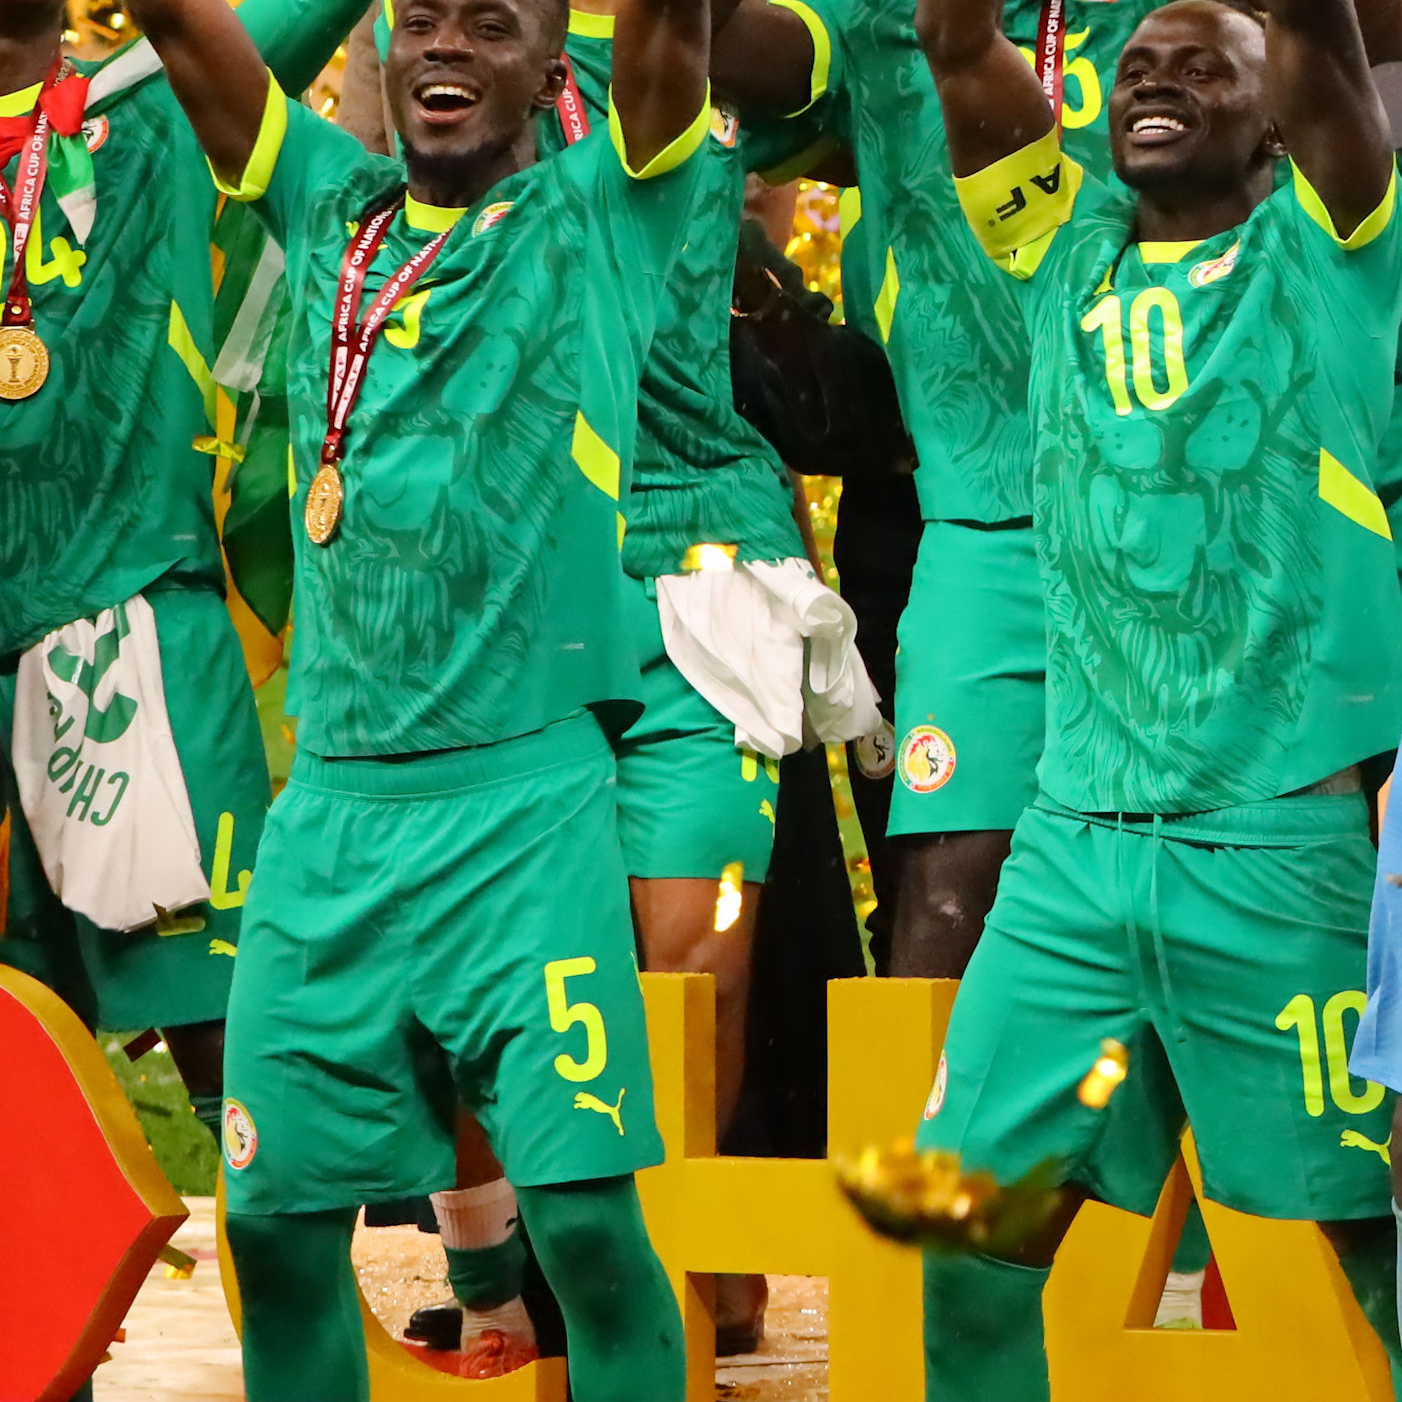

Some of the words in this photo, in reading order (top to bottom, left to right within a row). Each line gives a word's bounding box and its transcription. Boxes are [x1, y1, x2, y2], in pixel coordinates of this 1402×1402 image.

[1045, 34, 1058, 57] CUP
[1043, 56, 1056, 96] AFRICA
[31, 128, 46, 150] OF
[27, 150, 40, 176] CUP
[19, 177, 37, 221] AFRICA
[350, 248, 365, 267] OF
[343, 266, 357, 294] CUP
[338, 294, 352, 343] AFRICA
[359, 306, 386, 353] AFRICA
[380, 283, 400, 309] CUP
[397, 263, 413, 283] OF
[1081, 286, 1189, 416] 10
[544, 956, 607, 1082] 5
[1275, 990, 1386, 1117] 10
